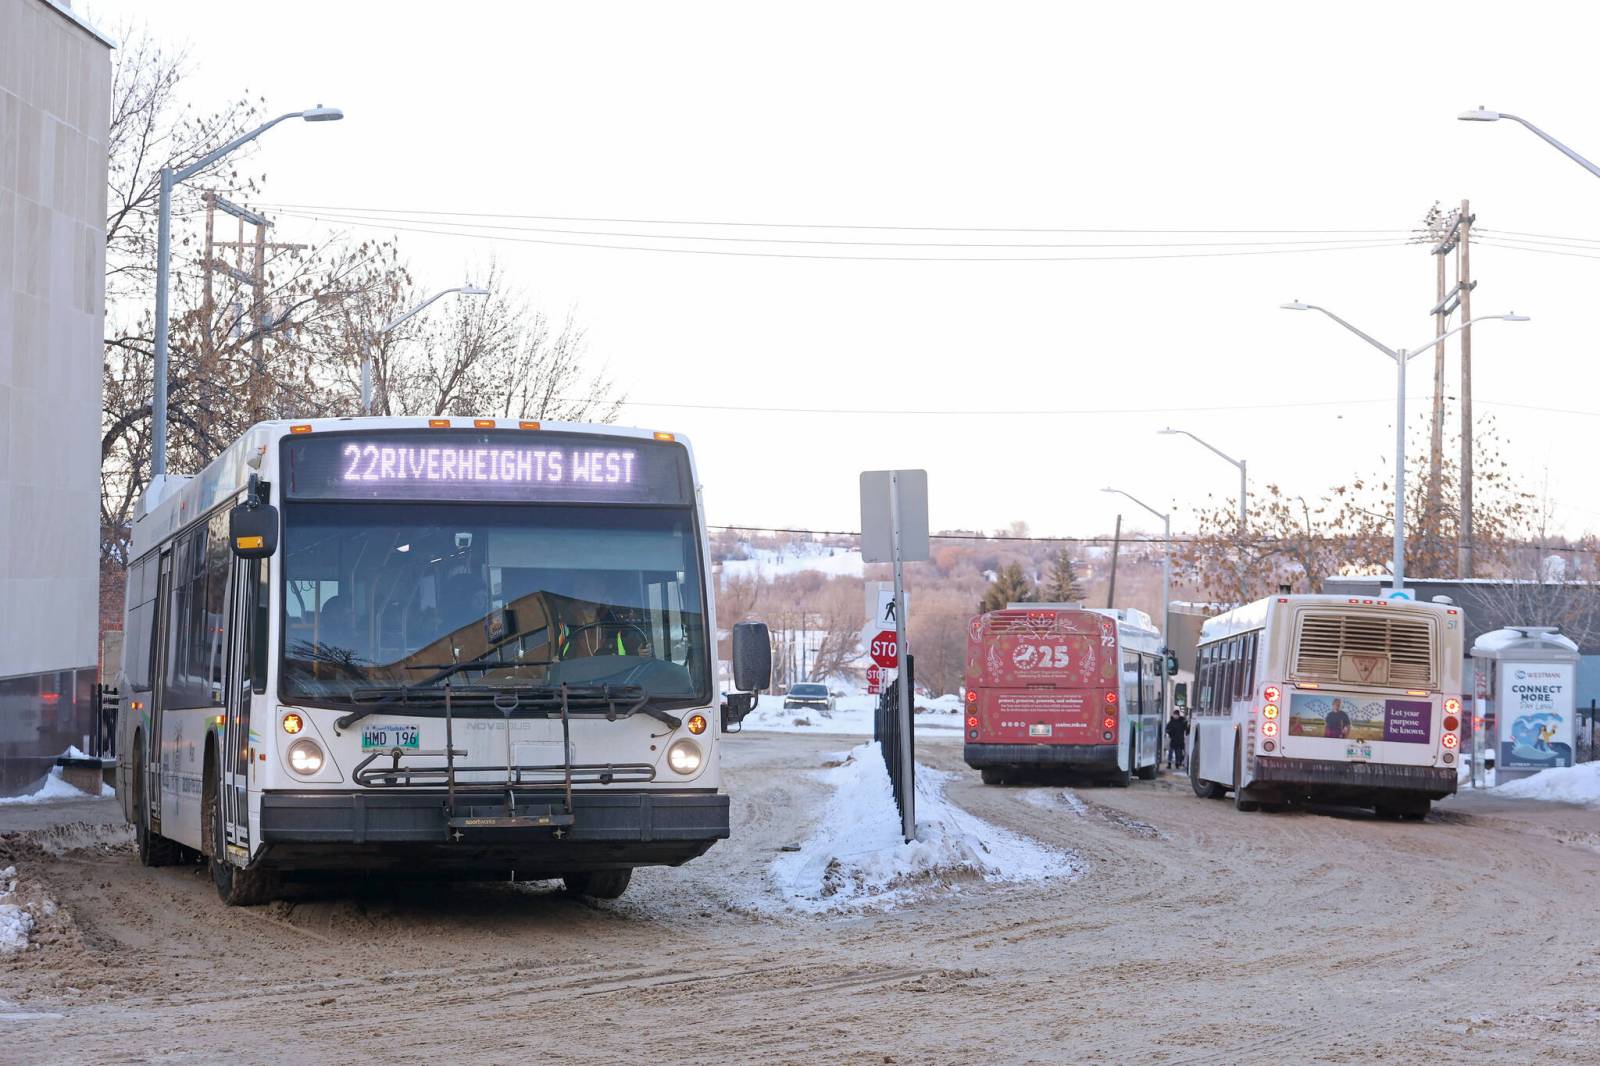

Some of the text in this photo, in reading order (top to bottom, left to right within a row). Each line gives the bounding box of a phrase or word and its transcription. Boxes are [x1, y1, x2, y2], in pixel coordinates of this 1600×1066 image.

[573, 451, 635, 483] WEST
[1101, 636, 1115, 647] 72
[872, 641, 897, 657] STO
[1039, 645, 1069, 668] 25
[867, 670, 880, 679] STO
[1512, 685, 1562, 693] CONNECT
[1391, 709, 1420, 719] Let your
[1390, 719, 1420, 727] purpose
[1390, 726, 1399, 734] be
[364, 731, 417, 746] HMD 196
